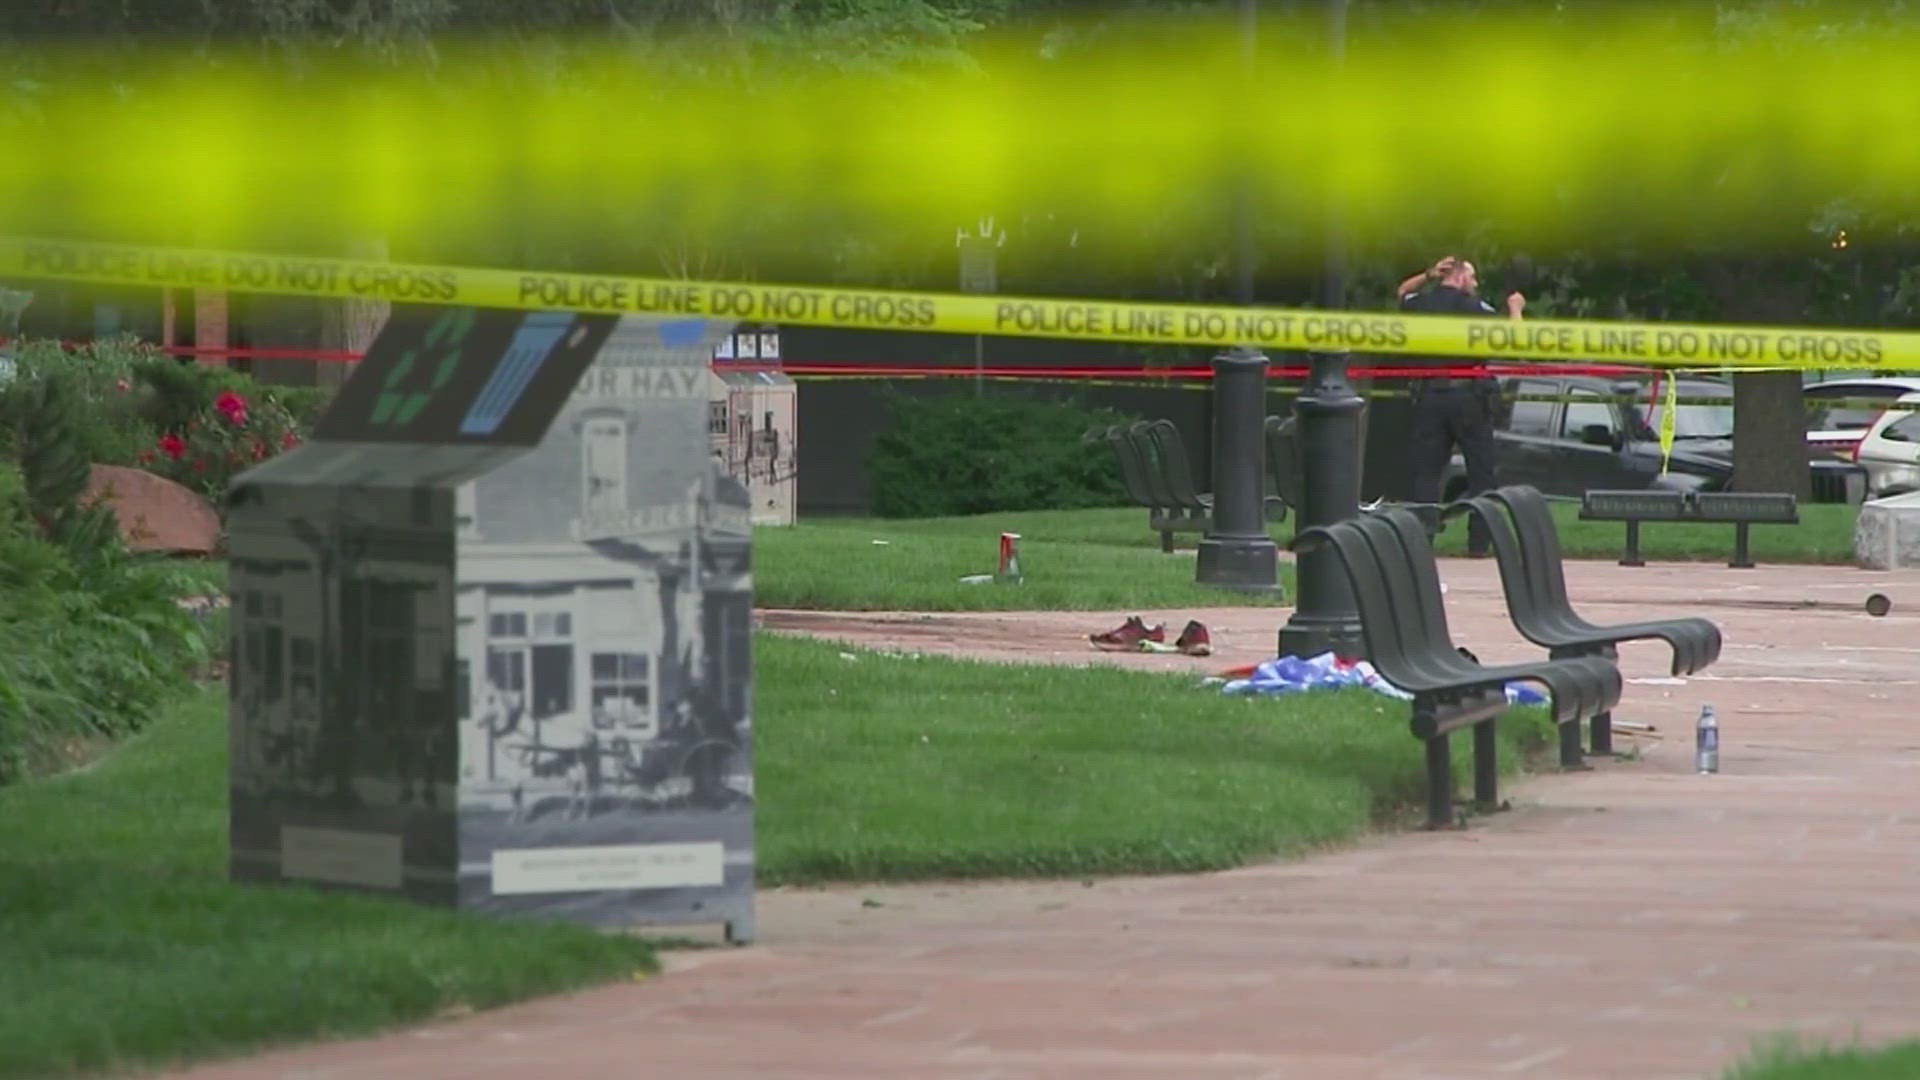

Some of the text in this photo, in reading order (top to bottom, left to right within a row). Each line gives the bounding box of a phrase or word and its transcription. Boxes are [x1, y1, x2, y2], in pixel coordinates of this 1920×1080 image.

[23, 244, 458, 301] POLICE LINE DO NOT CROSS
[519, 276, 936, 327] POLICE LINE DO NOT CROSS
[996, 302, 1408, 347] POLICE LINE DO NOT CROSS
[1468, 323, 1882, 363] POLICE LINE DO NOT CROSS
[632, 366, 700, 396] HAY
